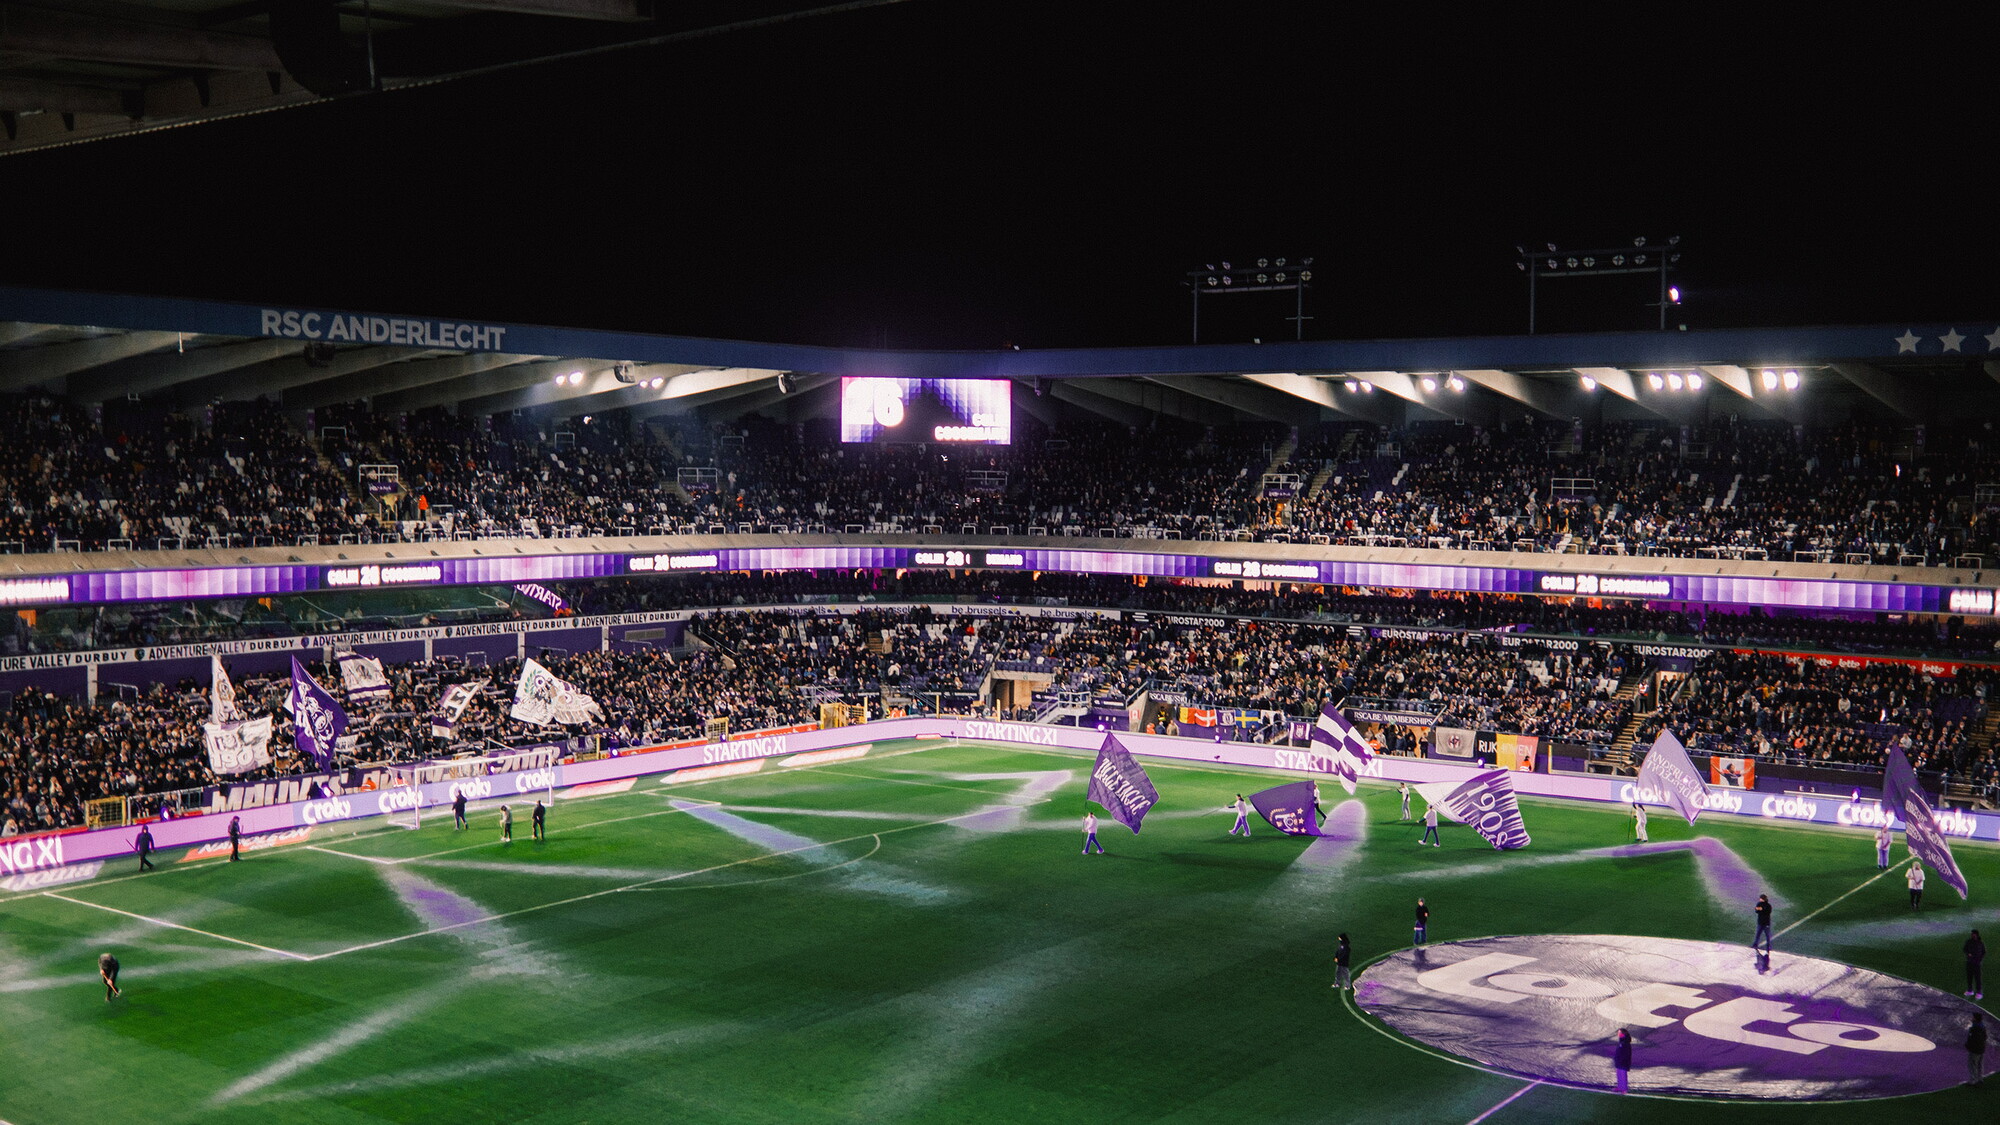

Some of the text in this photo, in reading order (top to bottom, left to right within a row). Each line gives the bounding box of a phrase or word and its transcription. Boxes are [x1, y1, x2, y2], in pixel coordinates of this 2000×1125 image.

[261, 309, 506, 350] RSC ANDERLECHT
[455, 619, 567, 636] ADVENTURE VALLEY DURBUY
[581, 611, 680, 628] ADVENTURE VALLEY DURBUY
[30, 653, 71, 669] VALLEY
[75, 651, 128, 664] DURBUY
[148, 639, 294, 660] ADVENTURE VALLEY DURBUY
[1921, 663, 1945, 675] lotto
[966, 721, 1058, 746] STARTING XI
[703, 736, 786, 764] STARTING XI
[1275, 750, 1361, 776] STARTIN
[515, 768, 555, 793] Croky
[1649, 751, 1702, 793] ANDERLECH
[378, 786, 423, 813] Croky
[449, 777, 492, 804] Croky
[1690, 790, 1742, 813] Croky
[302, 797, 351, 825] Croky
[1761, 795, 1817, 820] Croky
[1837, 801, 1895, 828] Croky
[1933, 808, 1977, 837] roky
[36, 835, 63, 867] XI
[1417, 952, 1936, 1055] lotto
